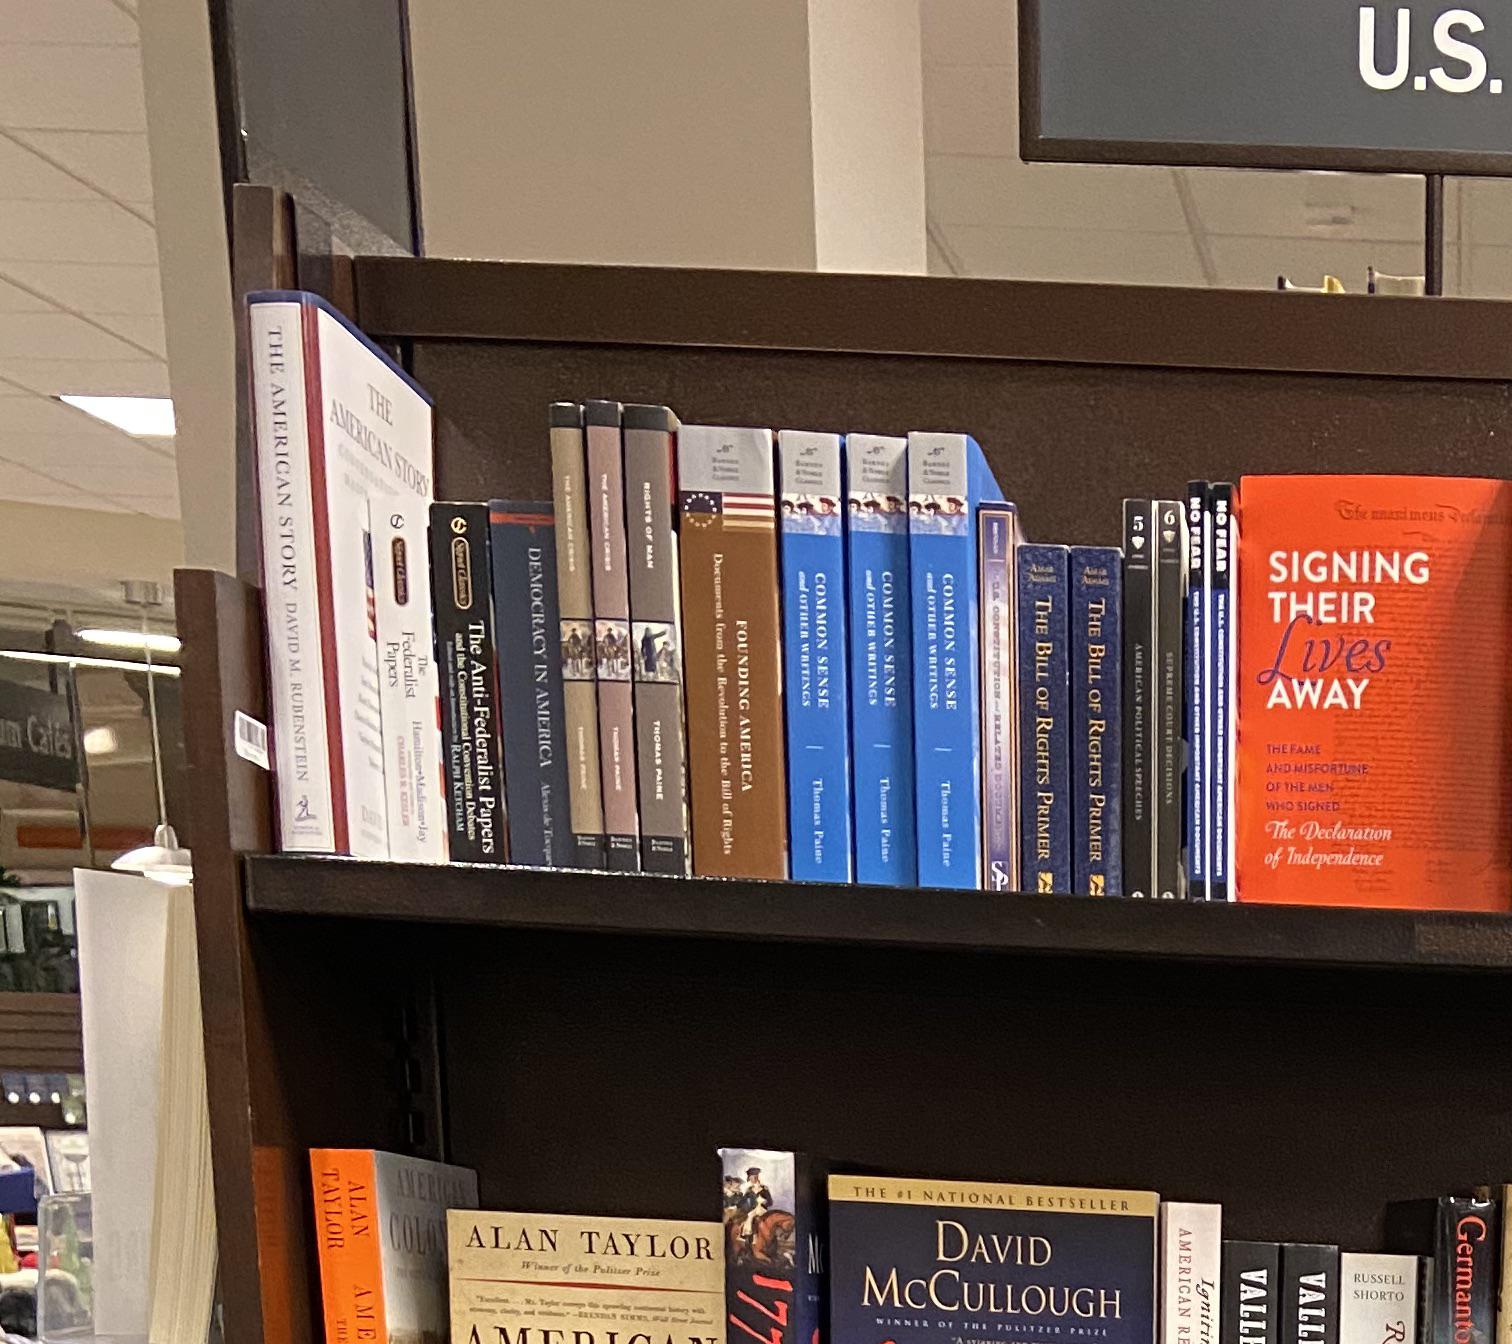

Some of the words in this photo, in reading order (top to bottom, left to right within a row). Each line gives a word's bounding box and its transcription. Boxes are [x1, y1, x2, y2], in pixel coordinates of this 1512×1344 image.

[1356, 7, 1503, 94] U.S.
[267, 327, 284, 375] THE
[269, 382, 292, 506] AMERICAN
[280, 516, 298, 595] STORY
[1268, 552, 1430, 583] SIGNING
[942, 574, 954, 651] COMMON
[1268, 592, 1375, 624] THEIR
[468, 620, 484, 655] The
[1257, 614, 1392, 685] Lives
[946, 658, 957, 710] SENSE
[1266, 679, 1370, 710] AWAY
[470, 657, 491, 789] Anti-Federalist
[477, 792, 494, 855] Papers
[853, 1187, 886, 1199] THE
[897, 1190, 911, 1200] #1
[923, 1191, 1015, 1205] NATIONAL
[1026, 1196, 1130, 1211] BESTSELLER
[466, 1226, 559, 1253] ALAN
[580, 1232, 713, 1260] TAYLOR
[935, 1220, 1052, 1267] DAVID
[1354, 1274, 1405, 1285] RUSSELL
[1354, 1289, 1404, 1301] SHORTO
